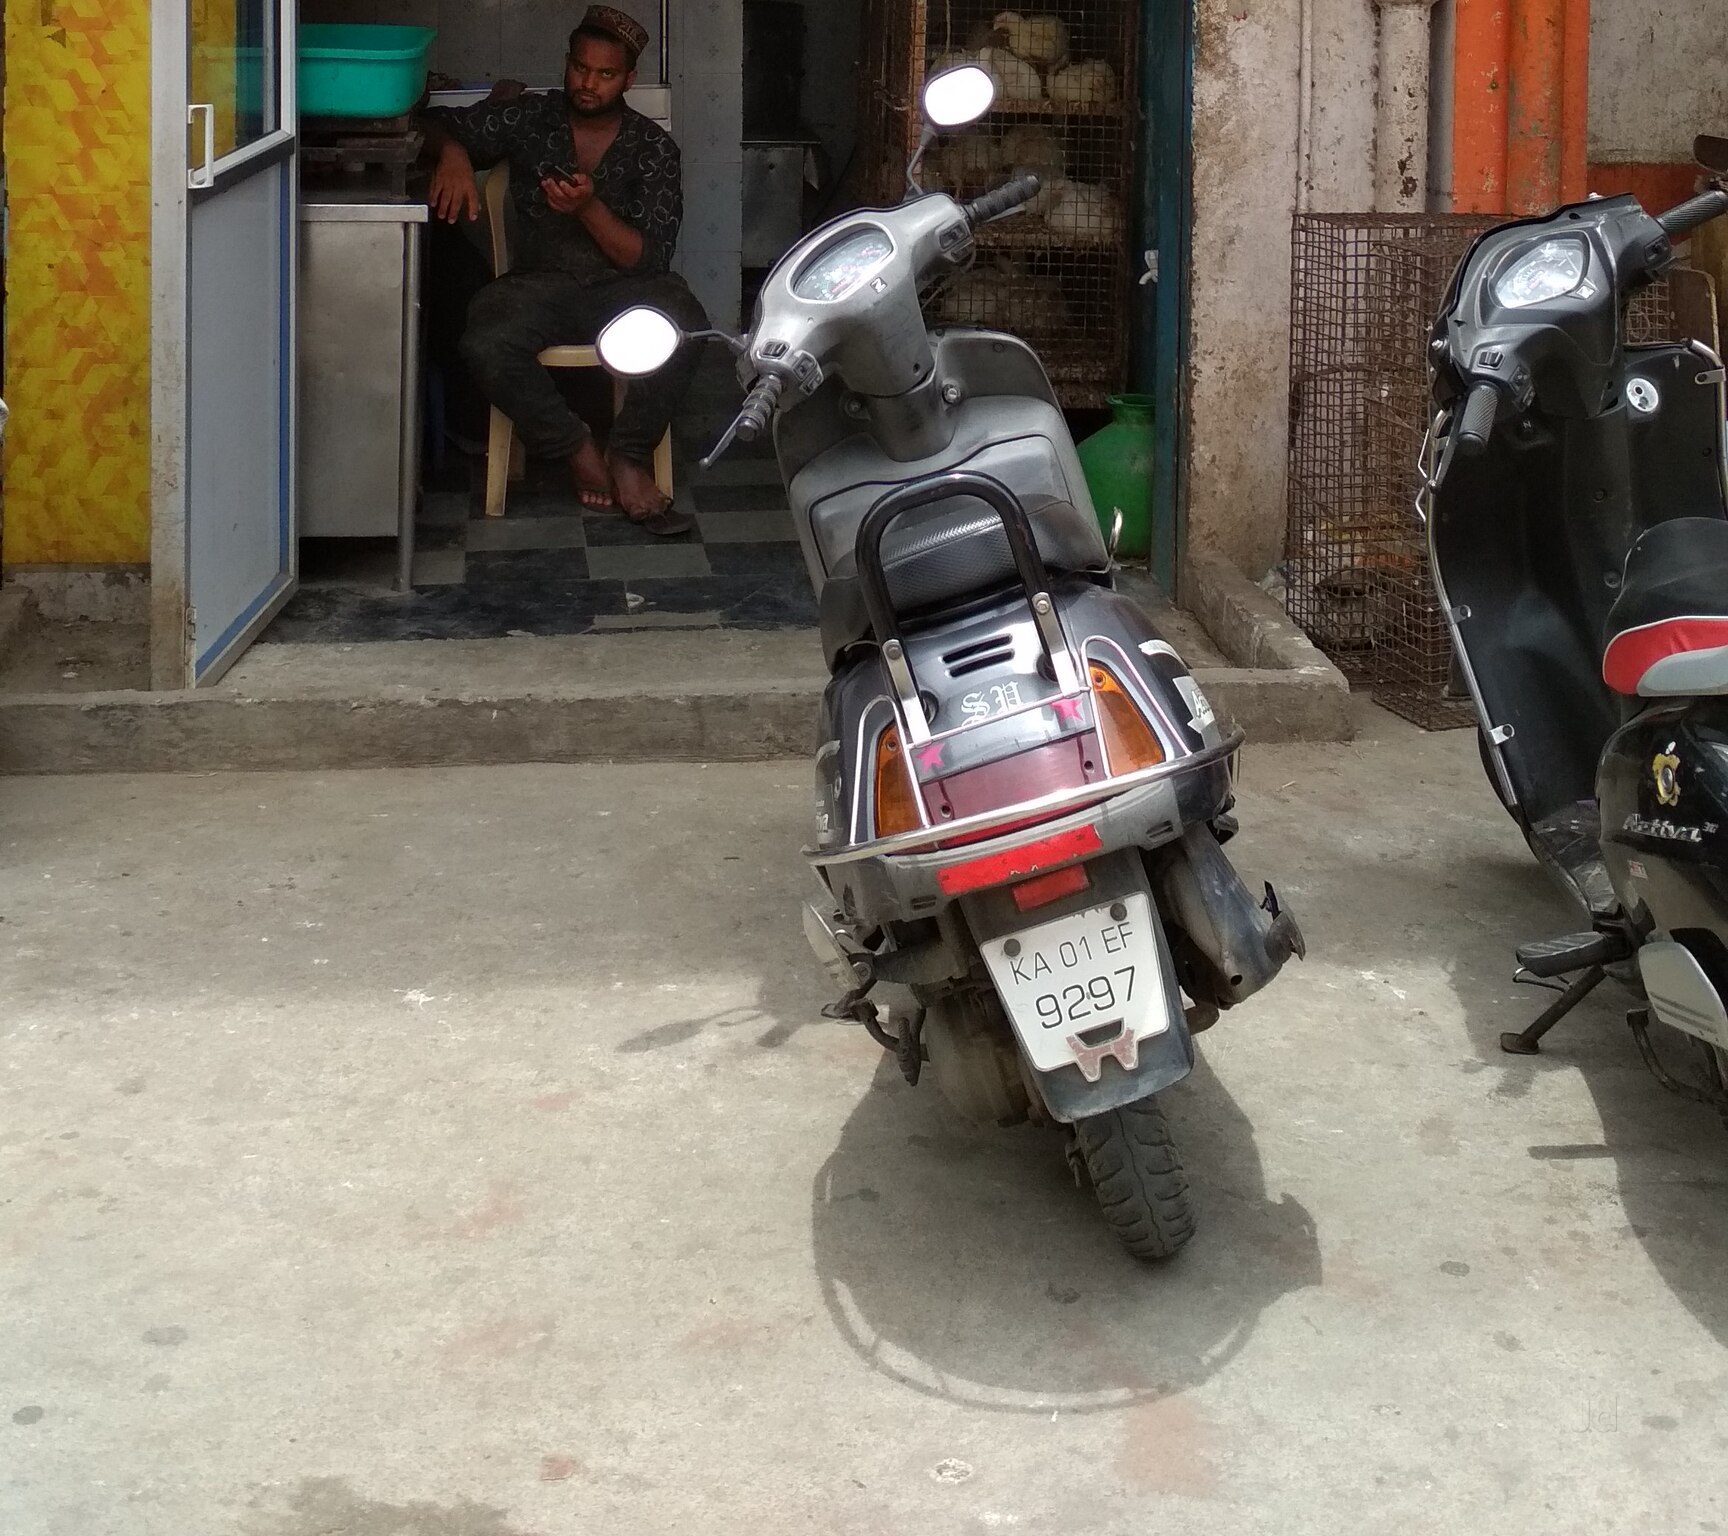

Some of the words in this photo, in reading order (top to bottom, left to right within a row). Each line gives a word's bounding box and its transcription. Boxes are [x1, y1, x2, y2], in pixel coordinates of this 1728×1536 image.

[1009, 951, 1053, 985] KA
[1059, 935, 1092, 968] 01
[1101, 921, 1133, 954] EF
[1035, 965, 1135, 1029] 9297
